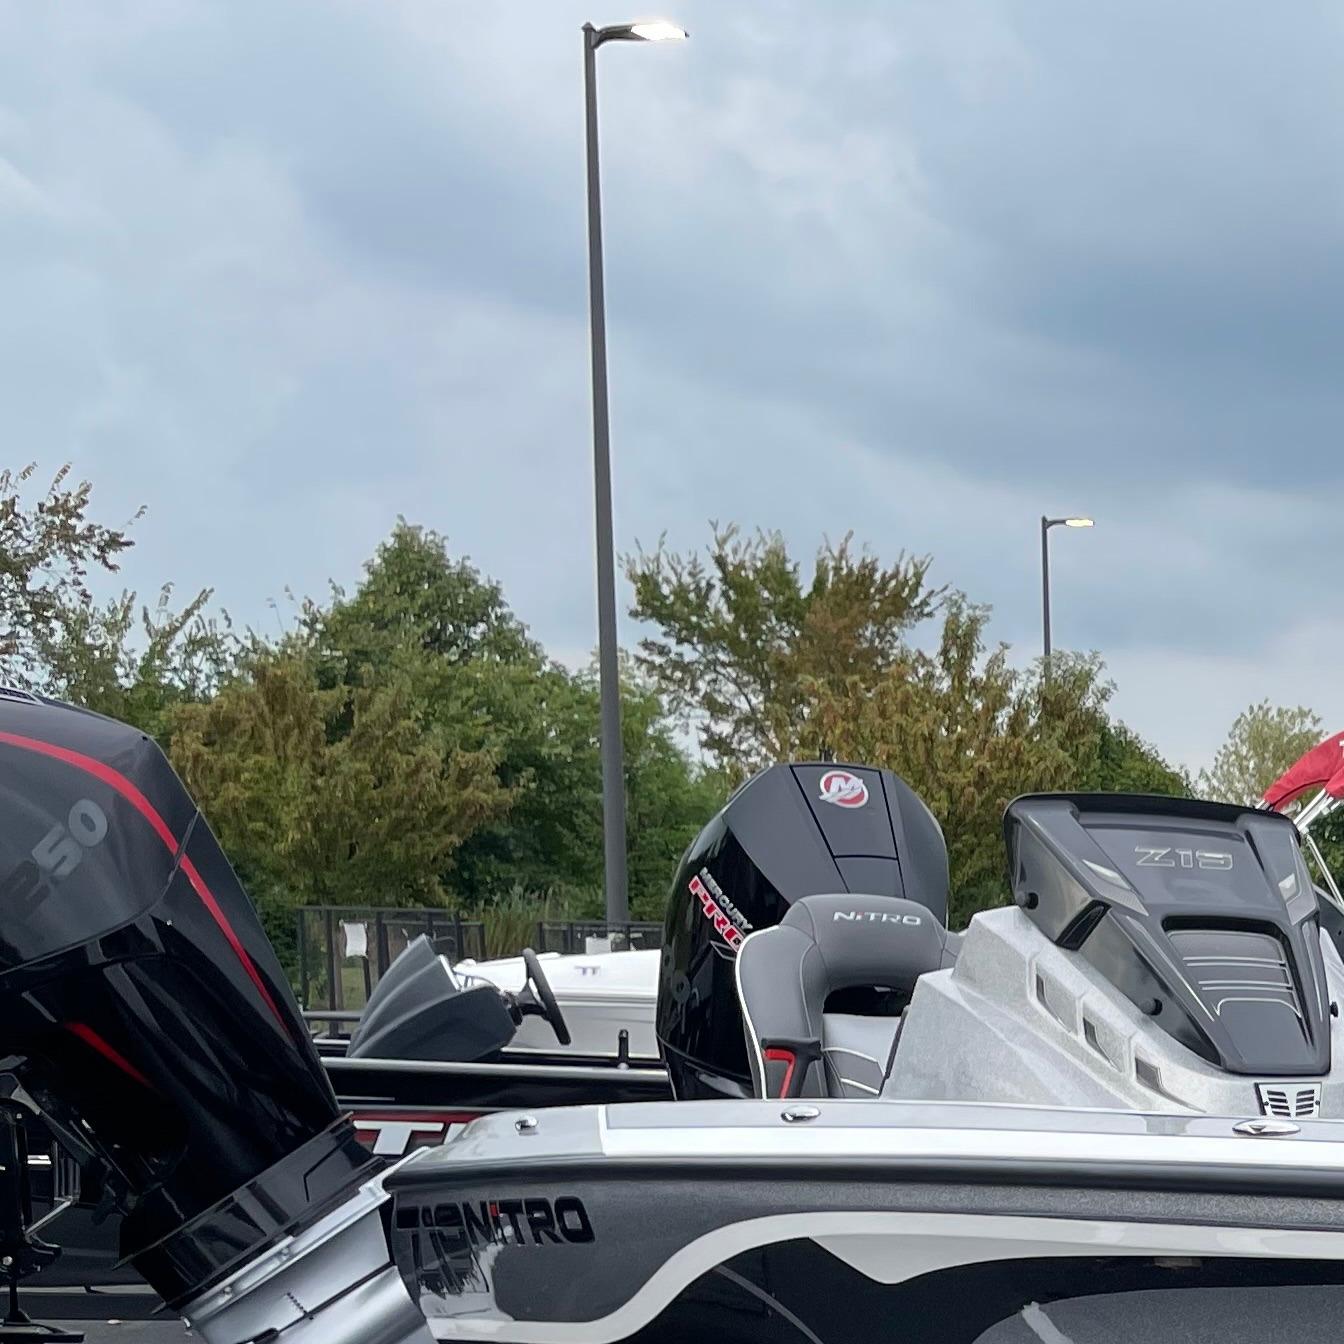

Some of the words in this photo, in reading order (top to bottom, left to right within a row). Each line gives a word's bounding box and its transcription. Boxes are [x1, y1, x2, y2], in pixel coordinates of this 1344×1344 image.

[699, 866, 753, 930] MERCURY
[832, 911, 921, 926] NITRO
[462, 1196, 595, 1247] NITRO
